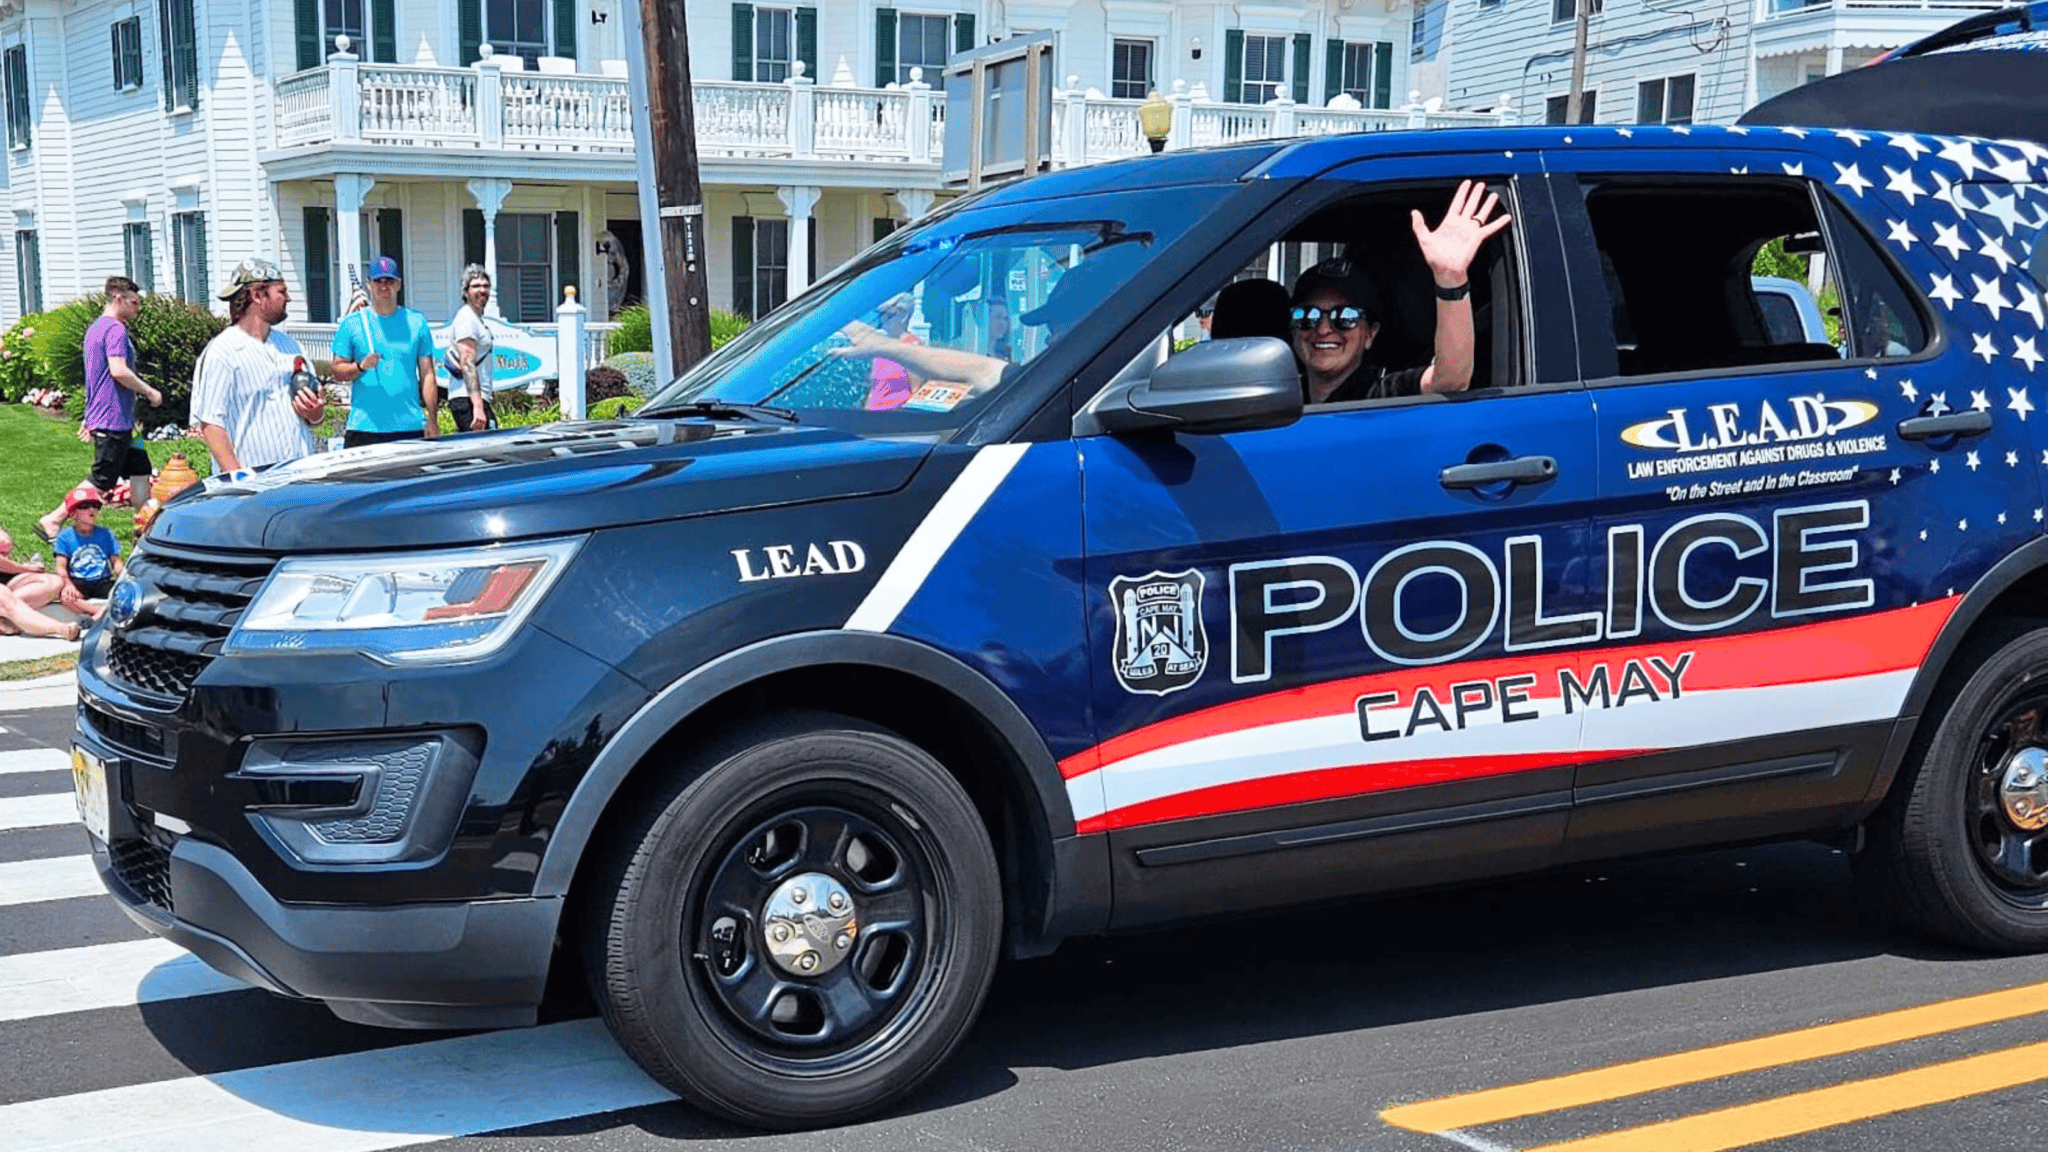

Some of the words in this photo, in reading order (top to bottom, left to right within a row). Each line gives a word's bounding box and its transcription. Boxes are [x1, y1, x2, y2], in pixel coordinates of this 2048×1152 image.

[1628, 461, 1655, 479] LAW
[1656, 451, 1738, 476] ENFORCEMENT
[1739, 446, 1785, 467] AGAINST
[1787, 442, 1825, 461] DRUGS
[1826, 441, 1837, 456] &
[1836, 434, 1887, 455] VIOLENCE
[1666, 485, 1688, 502] "On
[1689, 482, 1708, 500] the
[1708, 478, 1742, 497] Street
[1742, 475, 1765, 493] and
[1778, 472, 1796, 489] the
[1797, 464, 1859, 487] Classroom"
[730, 540, 866, 583] LEAD
[1139, 585, 1177, 599] POLICE
[1139, 604, 1160, 617] CAPE
[1161, 602, 1178, 613] MAY
[1229, 499, 1876, 684] POLICE
[1153, 644, 1168, 656] 20
[1167, 664, 1178, 672] AT
[1357, 674, 1540, 742] CAPE
[1557, 650, 1697, 716] MAY
